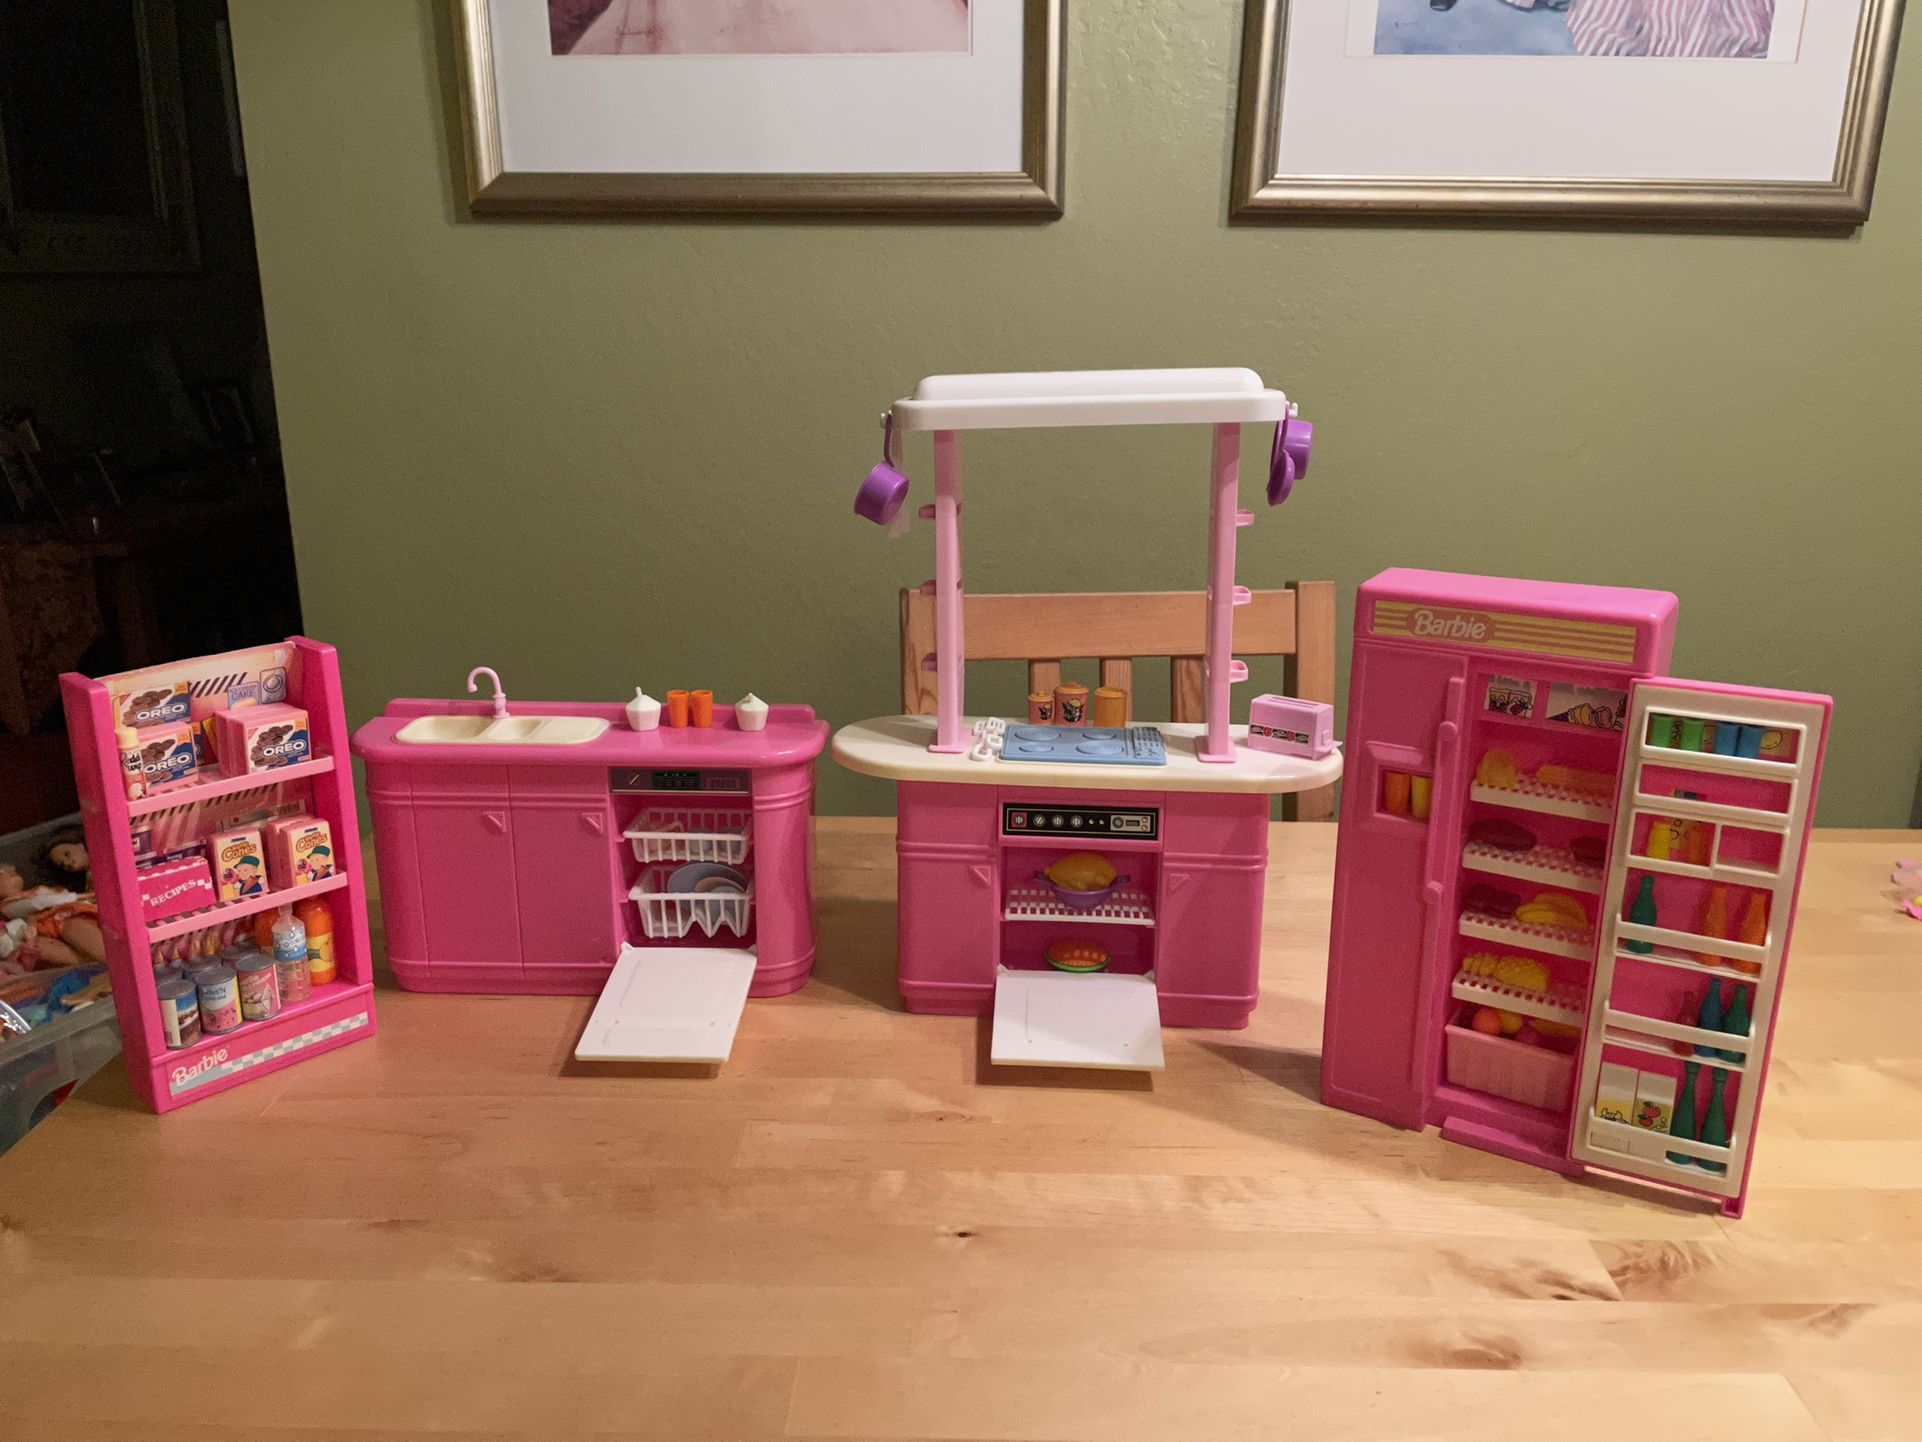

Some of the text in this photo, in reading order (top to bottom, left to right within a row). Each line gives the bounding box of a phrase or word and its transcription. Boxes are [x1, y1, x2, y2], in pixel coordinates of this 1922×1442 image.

[1414, 609, 1487, 639] Barbie
[136, 704, 185, 720] OREO
[263, 741, 305, 756] OREO
[143, 754, 190, 774] OREO
[222, 843, 257, 862] Cones
[296, 833, 328, 853] Cones
[150, 879, 196, 907] RECIPES
[172, 1048, 228, 1087] Barbie
